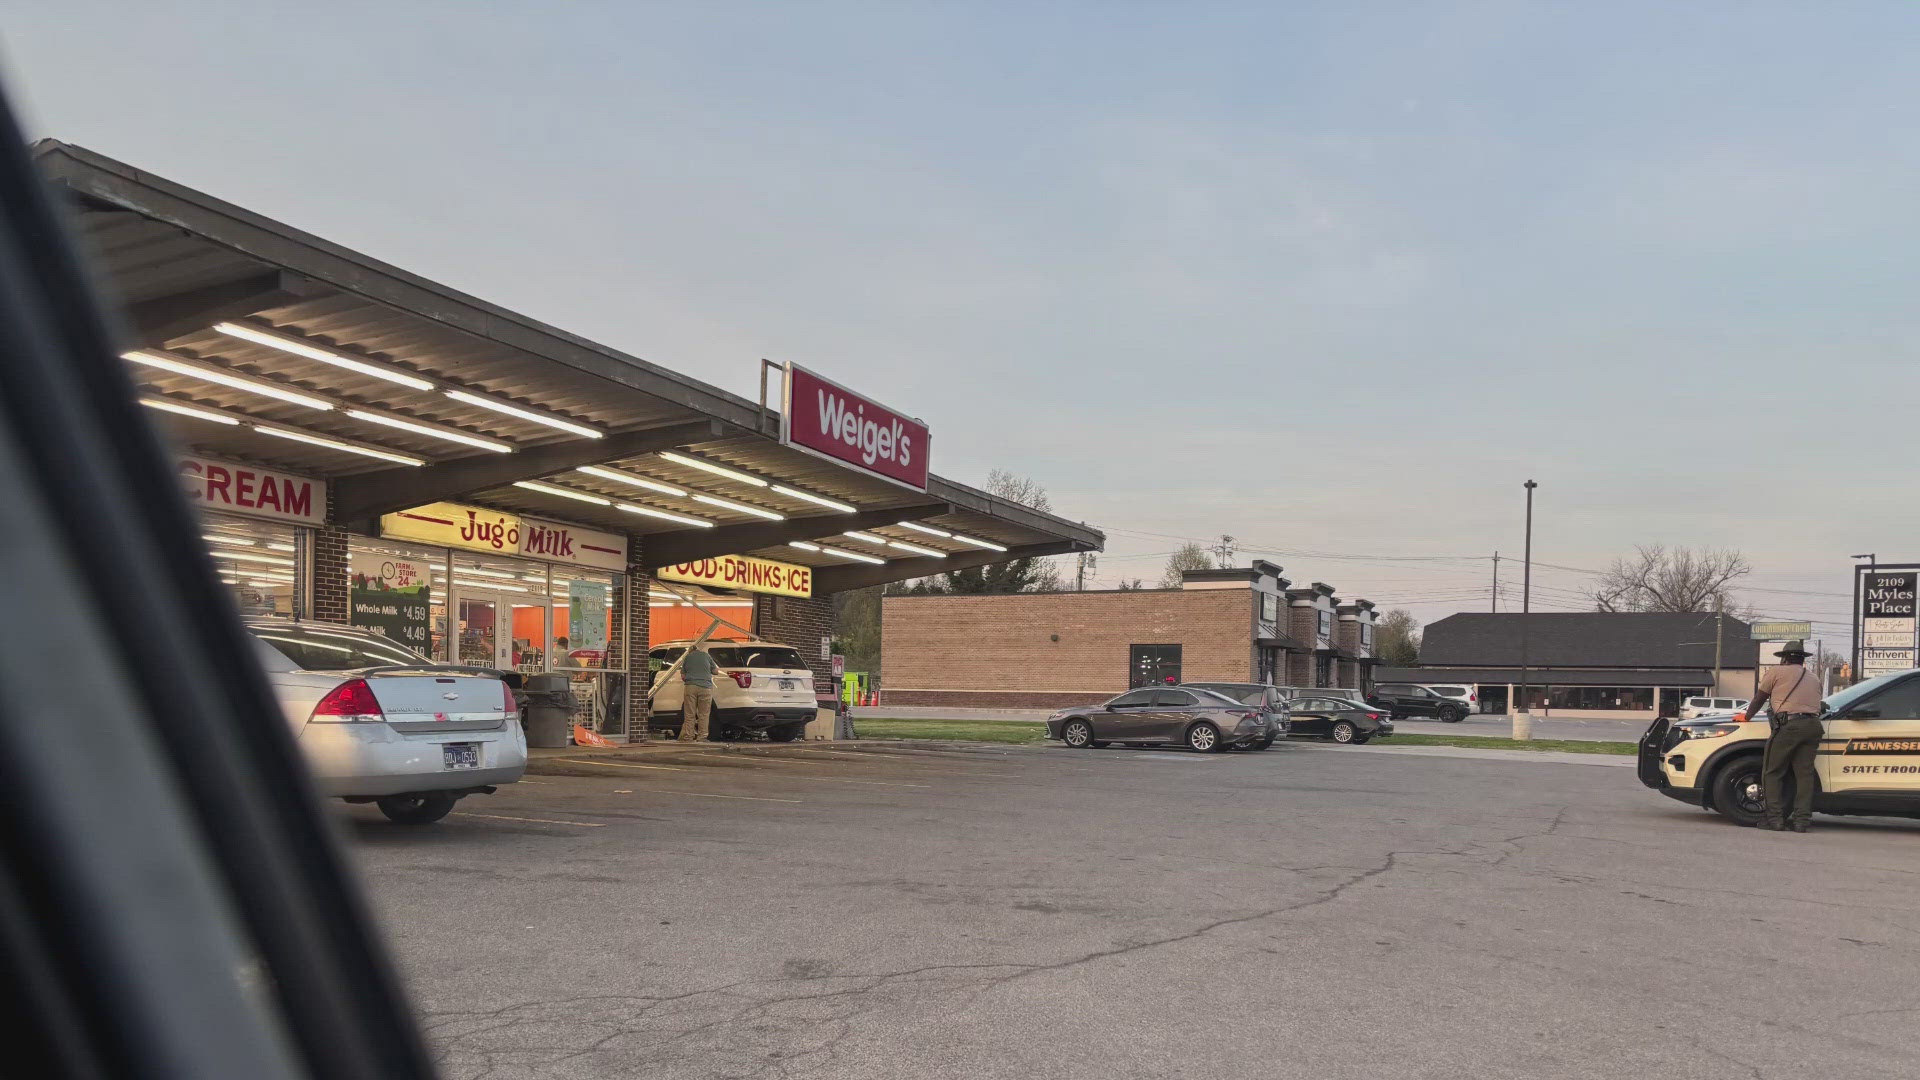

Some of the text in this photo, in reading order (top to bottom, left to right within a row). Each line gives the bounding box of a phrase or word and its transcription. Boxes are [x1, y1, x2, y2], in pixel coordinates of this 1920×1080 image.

[818, 388, 911, 467] Weigel's
[177, 460, 311, 517] CREAM
[460, 510, 505, 549] Jug
[525, 526, 575, 557] Milk
[398, 576, 410, 587] 24
[399, 570, 417, 578] STORE
[724, 558, 782, 589] DRINKS
[787, 568, 810, 593] ICE
[1877, 577, 1905, 587] 2109
[1868, 588, 1914, 603] Myles
[355, 603, 381, 614] Whole
[381, 605, 398, 616] Milk
[403, 605, 426, 621] $4.59
[1869, 602, 1912, 614] Place
[402, 625, 425, 641] $4.49
[1867, 650, 1908, 659] thrivent
[1842, 765, 1920, 774] STATE TROO
